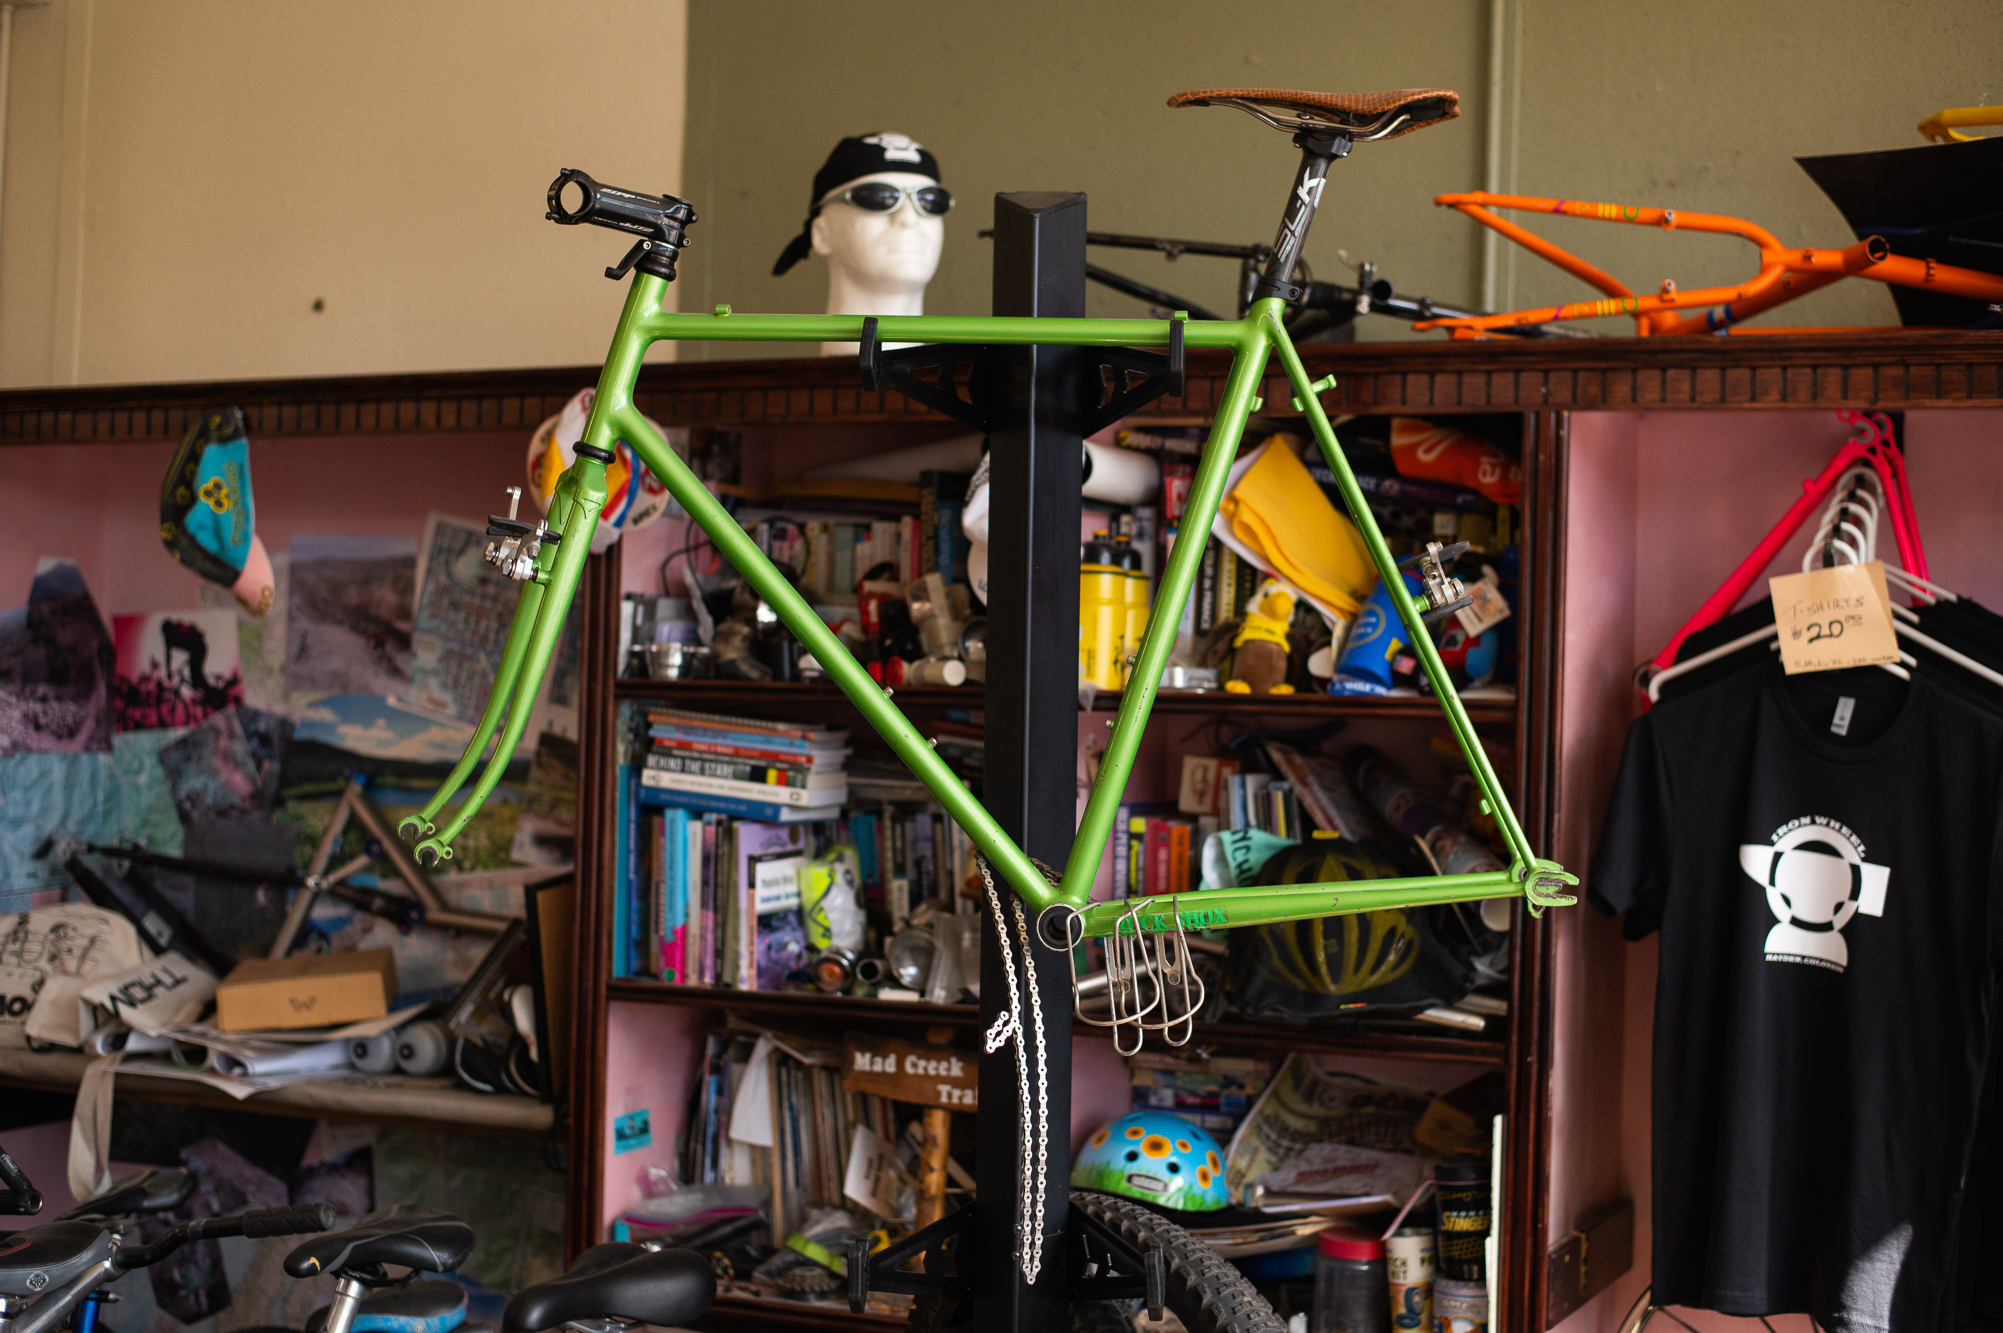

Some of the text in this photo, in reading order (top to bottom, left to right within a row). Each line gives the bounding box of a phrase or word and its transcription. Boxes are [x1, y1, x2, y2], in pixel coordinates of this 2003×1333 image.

[646, 753, 683, 772] BEHIND
[684, 757, 701, 775] THE
[1771, 815, 1866, 858] IRON WHEEL
[1176, 907, 1228, 931] SHOX
[853, 1051, 965, 1078] Mad Creek
[936, 1083, 978, 1105] Tra
